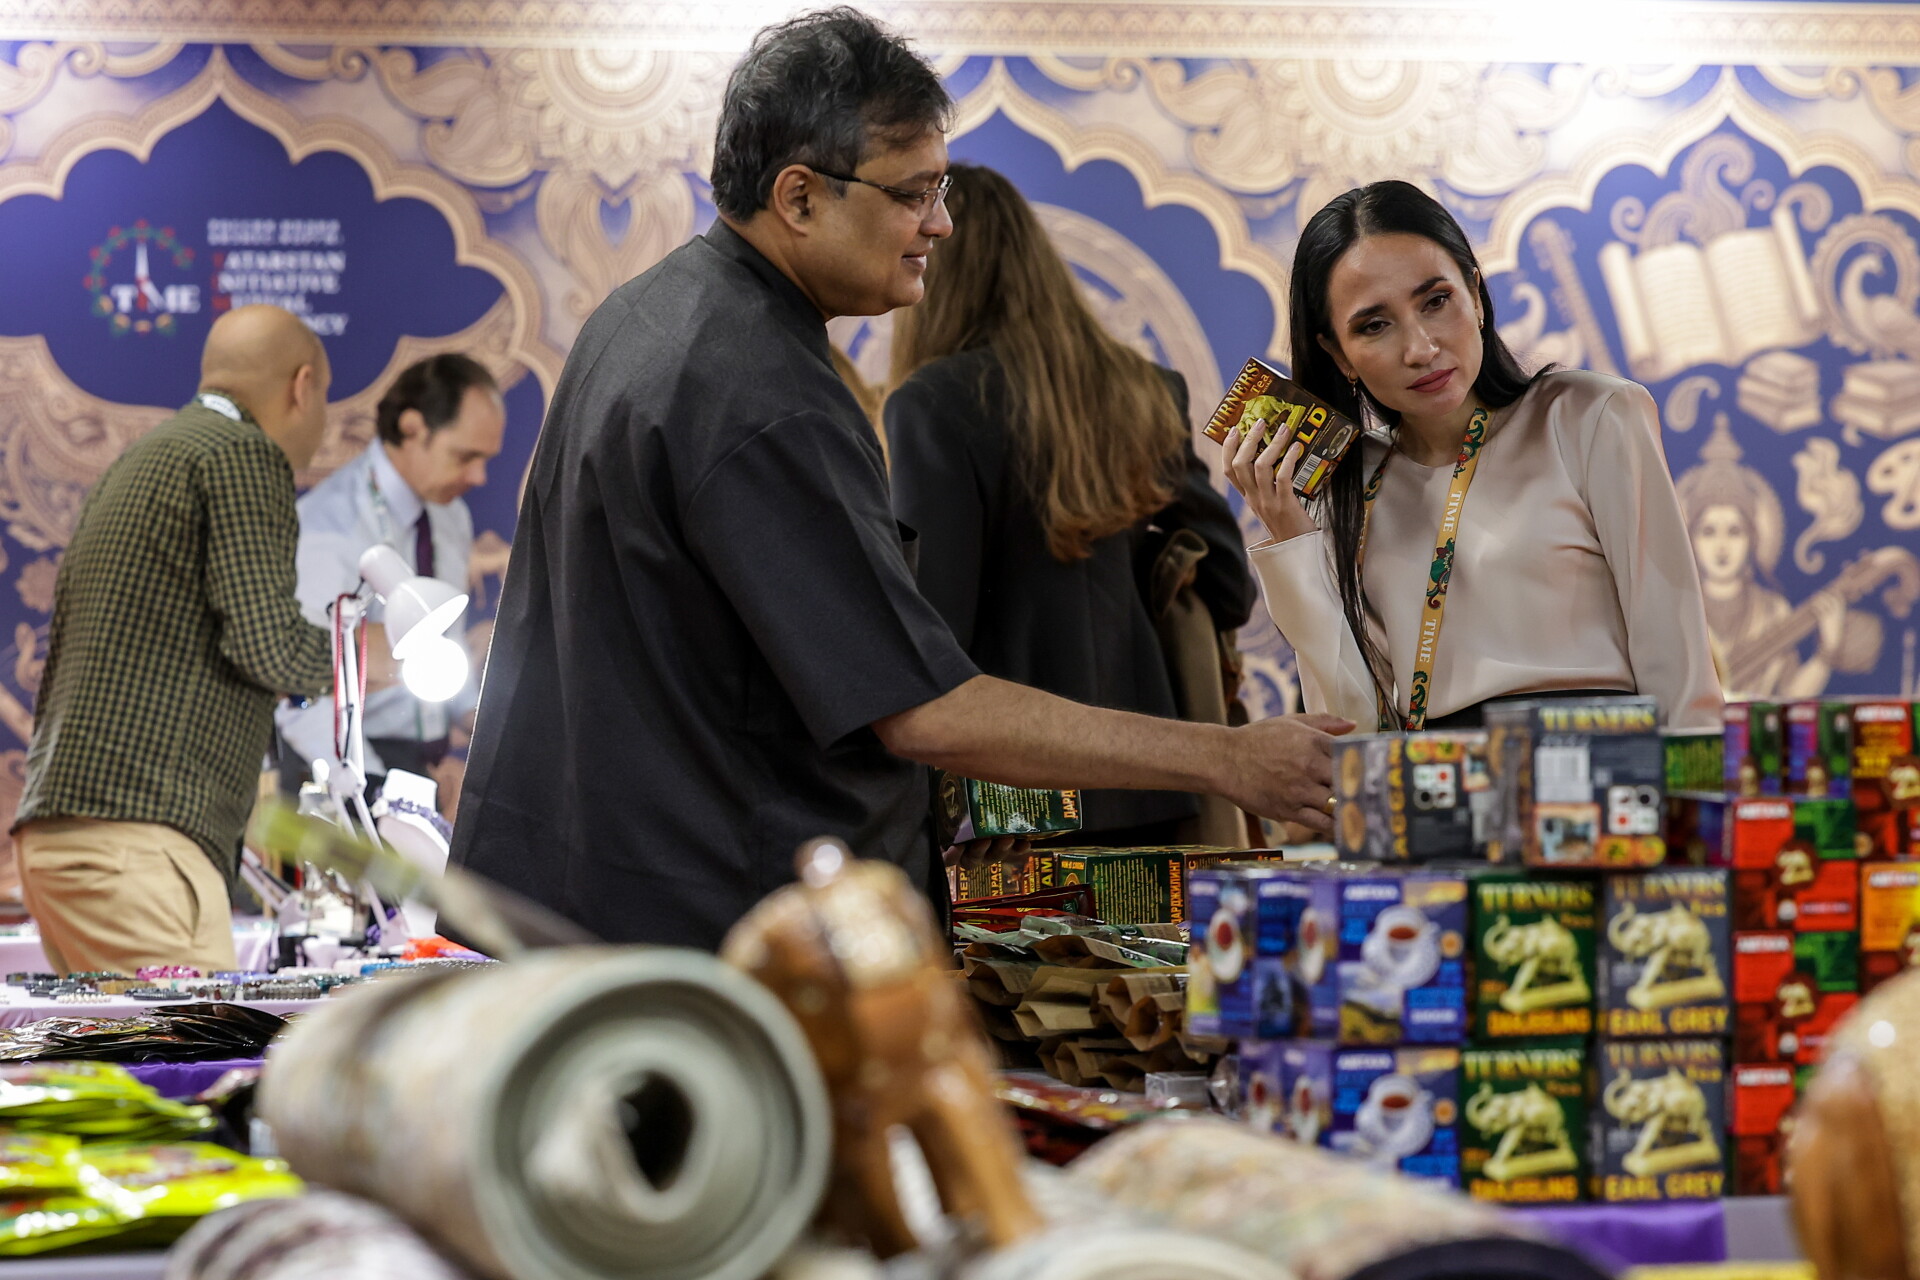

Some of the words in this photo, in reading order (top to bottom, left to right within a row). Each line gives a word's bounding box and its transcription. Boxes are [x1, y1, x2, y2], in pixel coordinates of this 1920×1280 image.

[1203, 363, 1260, 436] TURNERS
[1250, 373, 1270, 394] Tea
[1442, 490, 1463, 533] TIME
[1418, 618, 1437, 663] TIME
[1609, 1008, 1666, 1036] EARL
[1669, 1006, 1728, 1034] GREY
[1604, 1175, 1661, 1201] EARL
[1665, 1172, 1725, 1200] GREY
